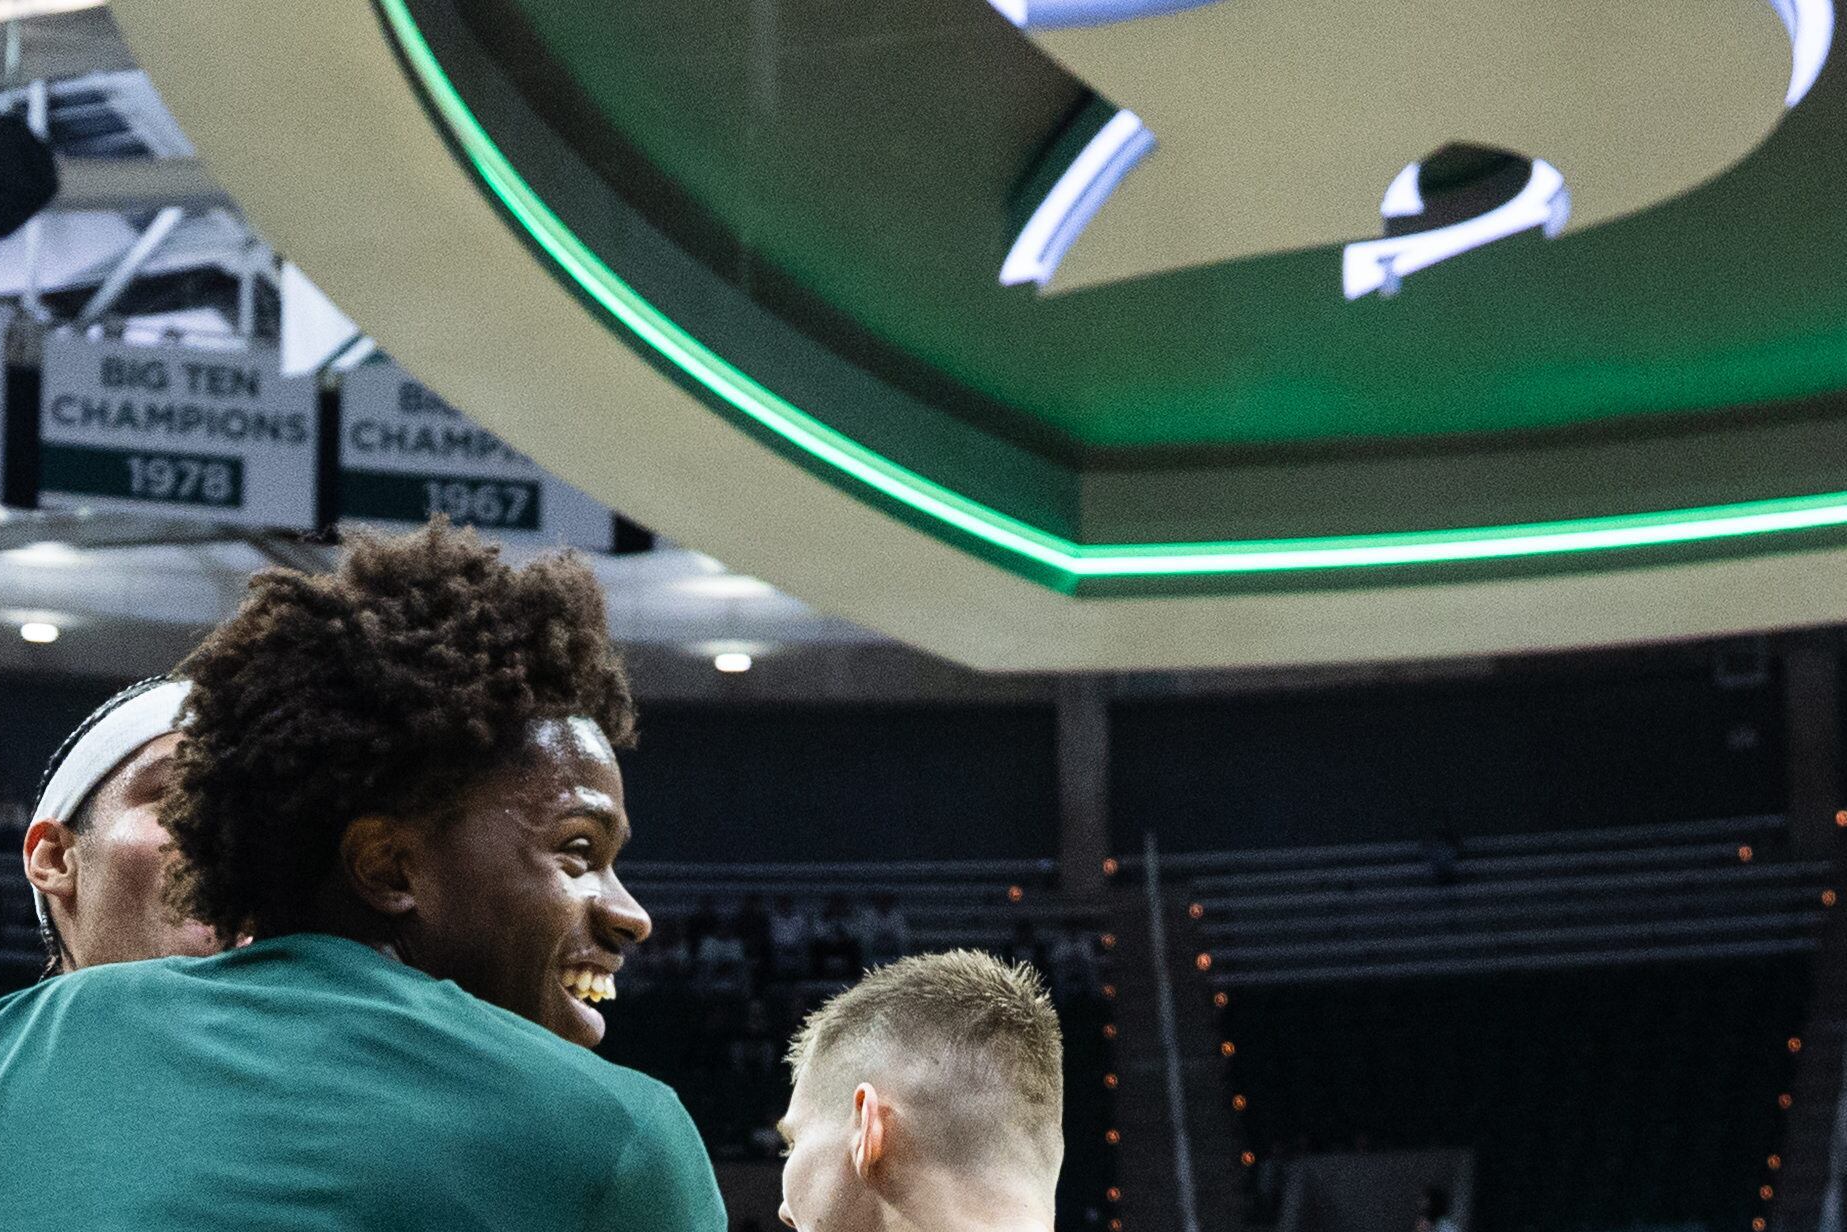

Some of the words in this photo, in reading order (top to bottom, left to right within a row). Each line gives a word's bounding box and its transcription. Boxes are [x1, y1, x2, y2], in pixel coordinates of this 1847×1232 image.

[102, 357, 168, 390] BIG
[182, 362, 260, 398] TEN
[52, 395, 306, 443] CHAMPIONS
[128, 457, 233, 499] 1978
[425, 482, 530, 523] 1967
